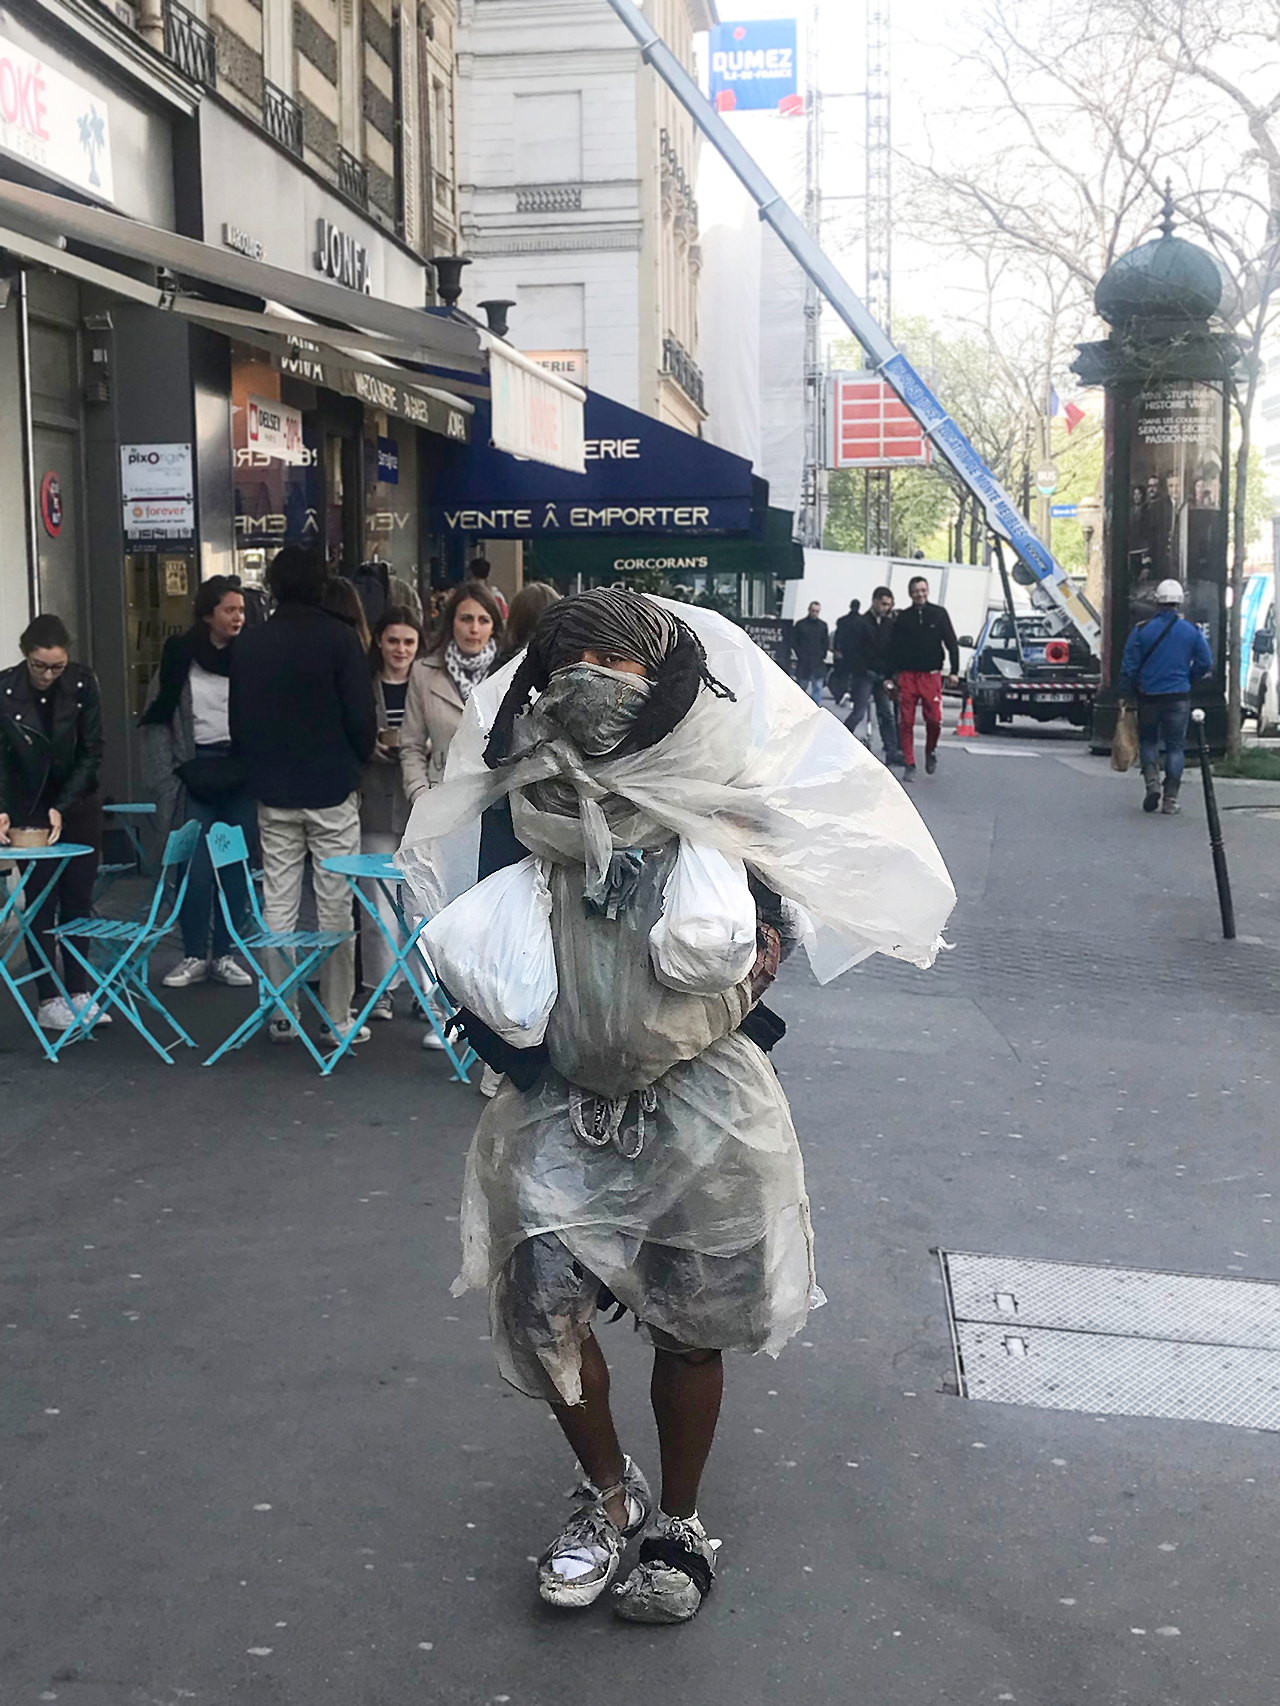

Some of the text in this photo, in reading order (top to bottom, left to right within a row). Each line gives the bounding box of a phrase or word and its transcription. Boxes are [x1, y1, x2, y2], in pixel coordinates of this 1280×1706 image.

[713, 48, 793, 72] DUMEZ
[314, 217, 372, 297] JONFA
[1138, 425, 1180, 435] SERVICES
[937, 423, 1028, 540] LOCATION DE MONTE MEUBLES
[1038, 470, 1056, 480] BUS
[145, 506, 186, 518] forever
[444, 509, 532, 530] VENTE
[569, 506, 710, 528] EMPORTER
[613, 557, 709, 571] CORCORAN'S
